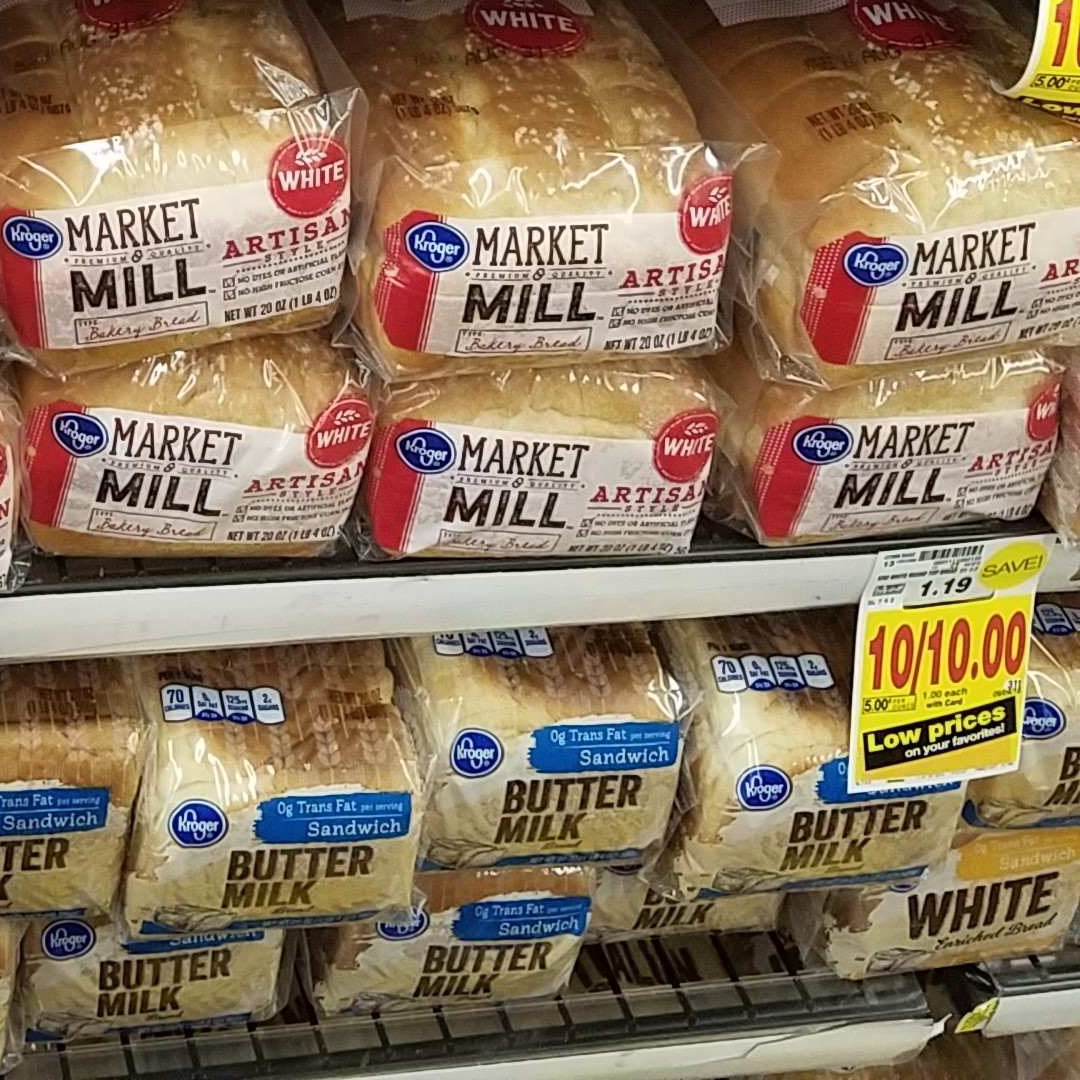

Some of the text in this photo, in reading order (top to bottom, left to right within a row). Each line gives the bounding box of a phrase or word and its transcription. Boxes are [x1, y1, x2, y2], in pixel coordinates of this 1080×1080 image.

[479, 9, 578, 34] WHITE
[277, 159, 344, 191] WHITE
[11, 225, 54, 251] Kroger
[65, 198, 200, 252] MARKET
[472, 224, 609, 266] MARKET
[909, 222, 1036, 277] MARKET
[71, 258, 207, 313] MILL
[462, 282, 596, 323] MILL
[895, 280, 1019, 332] MILL
[109, 417, 242, 466] MARKET
[317, 421, 371, 448] WHITE
[664, 433, 714, 456] WHITE
[853, 422, 975, 459] MARKET
[458, 434, 590, 478] MARKET
[96, 468, 221, 517] MILL
[443, 486, 568, 528] MILL
[833, 469, 947, 509] MILL
[921, 577, 972, 597] 1.19
[982, 556, 1043, 578] SAVE!
[870, 611, 1026, 695] 10/10.00
[923, 688, 967, 699] 1.00 each
[944, 698, 963, 706] Card
[867, 706, 1006, 752] Low prices
[905, 723, 1005, 758] on your favorites!
[579, 746, 669, 767] Sandwich
[34, 792, 54, 806] Fat
[502, 774, 643, 813] BUTTER
[2, 810, 98, 831] Sandwich
[307, 818, 401, 836] Sandwich
[494, 813, 586, 845] MILK
[790, 800, 927, 843] BUTTER
[227, 844, 374, 882] BUTTER
[779, 838, 870, 872] MILK
[224, 881, 317, 909] MILK
[908, 871, 1060, 941] WHITE
[498, 915, 579, 937] Sandwich
[99, 948, 232, 990] BUTTER
[423, 941, 551, 974] BUTTER
[97, 986, 182, 1018] MILK
[413, 974, 498, 998] MILK
